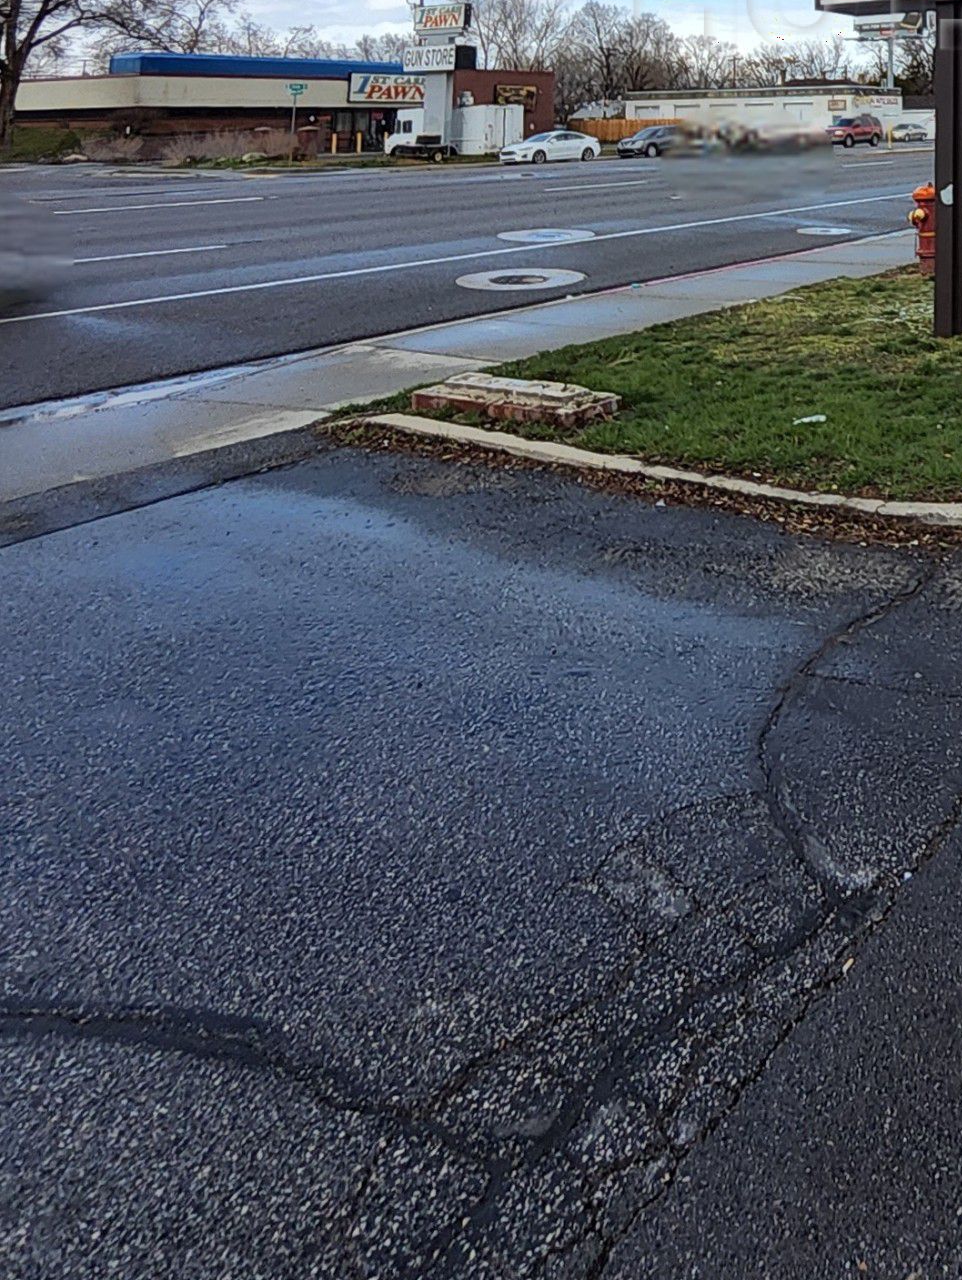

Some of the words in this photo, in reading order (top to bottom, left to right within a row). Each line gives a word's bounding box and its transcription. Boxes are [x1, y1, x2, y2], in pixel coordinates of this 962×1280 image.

[423, 13, 460, 28] PAWN
[405, 48, 424, 68] GUN
[425, 47, 455, 66] STORE
